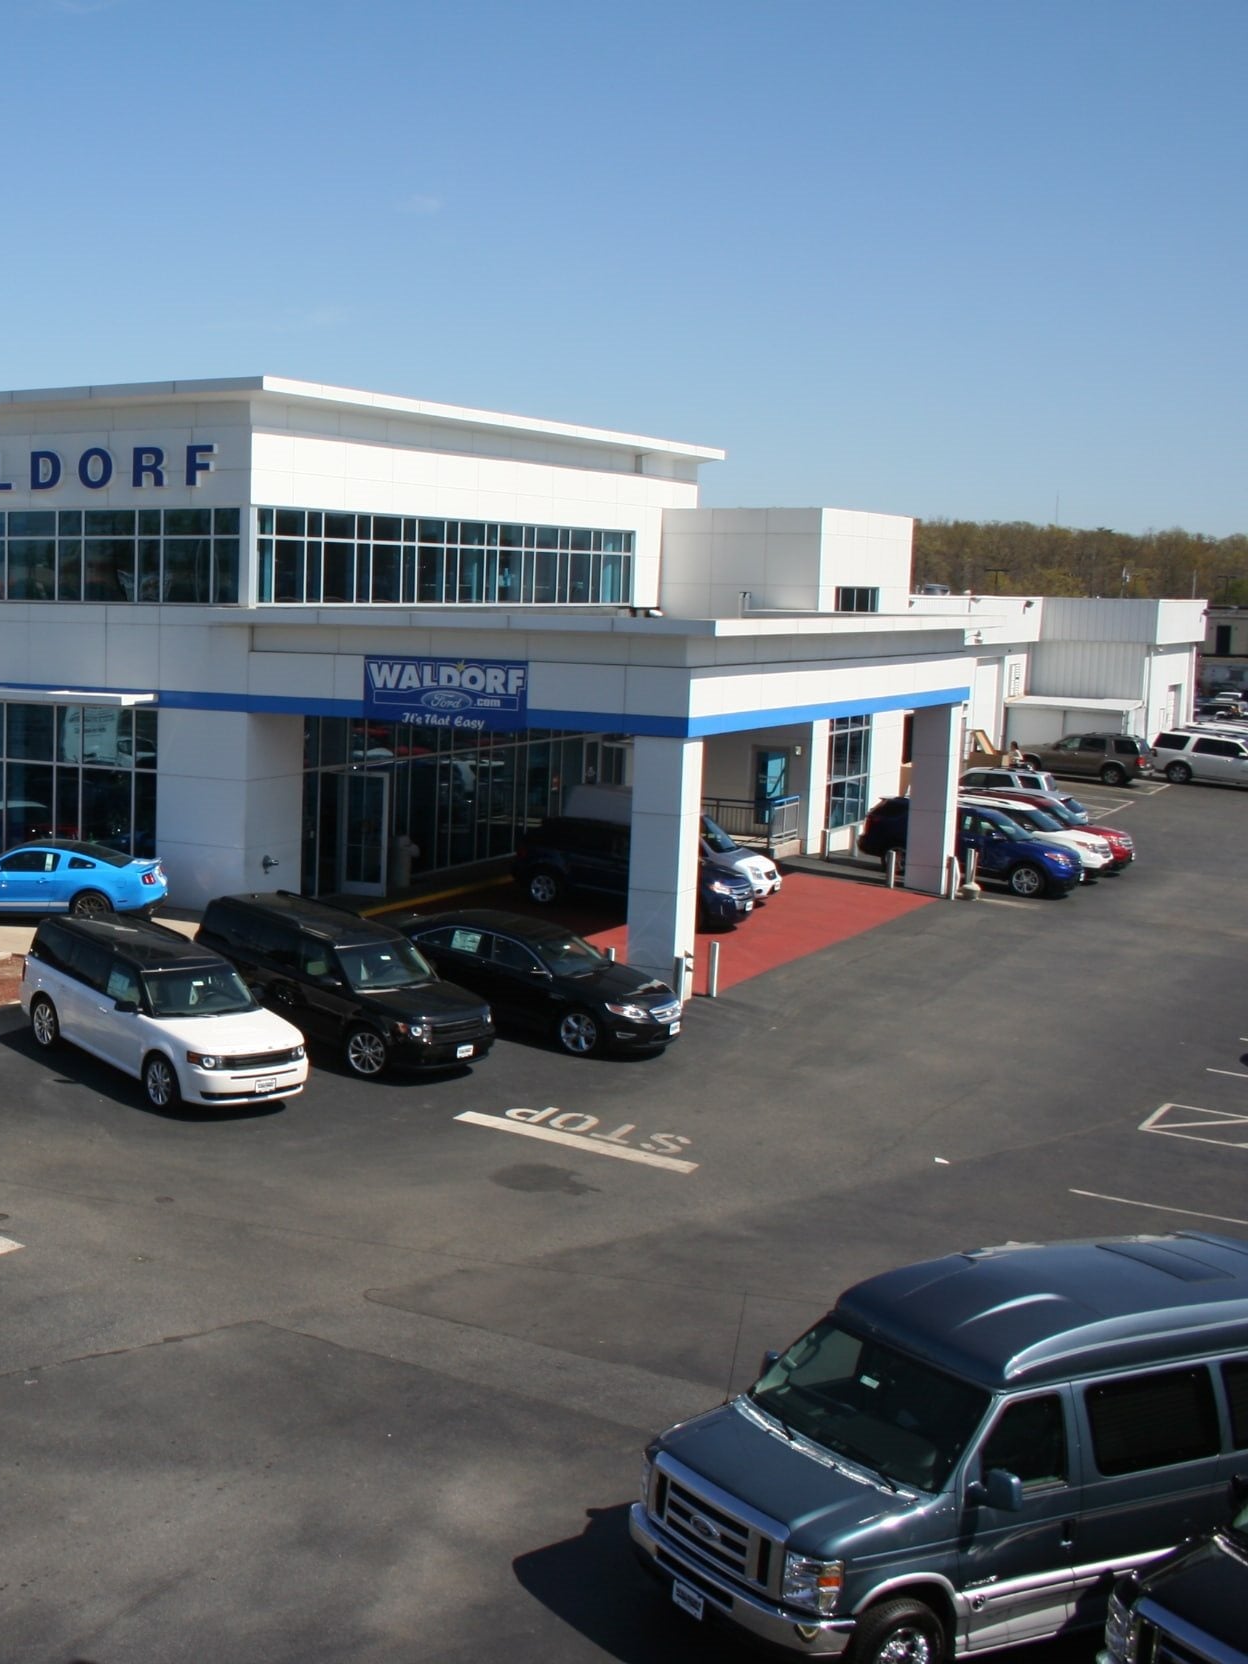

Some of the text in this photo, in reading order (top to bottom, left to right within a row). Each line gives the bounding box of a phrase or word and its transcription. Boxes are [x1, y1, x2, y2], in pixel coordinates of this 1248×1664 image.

[368, 662, 525, 695] WALDORF
[430, 693, 501, 709] Ford .com
[402, 712, 485, 730] It's That Easy
[505, 1106, 692, 1153] STOP
